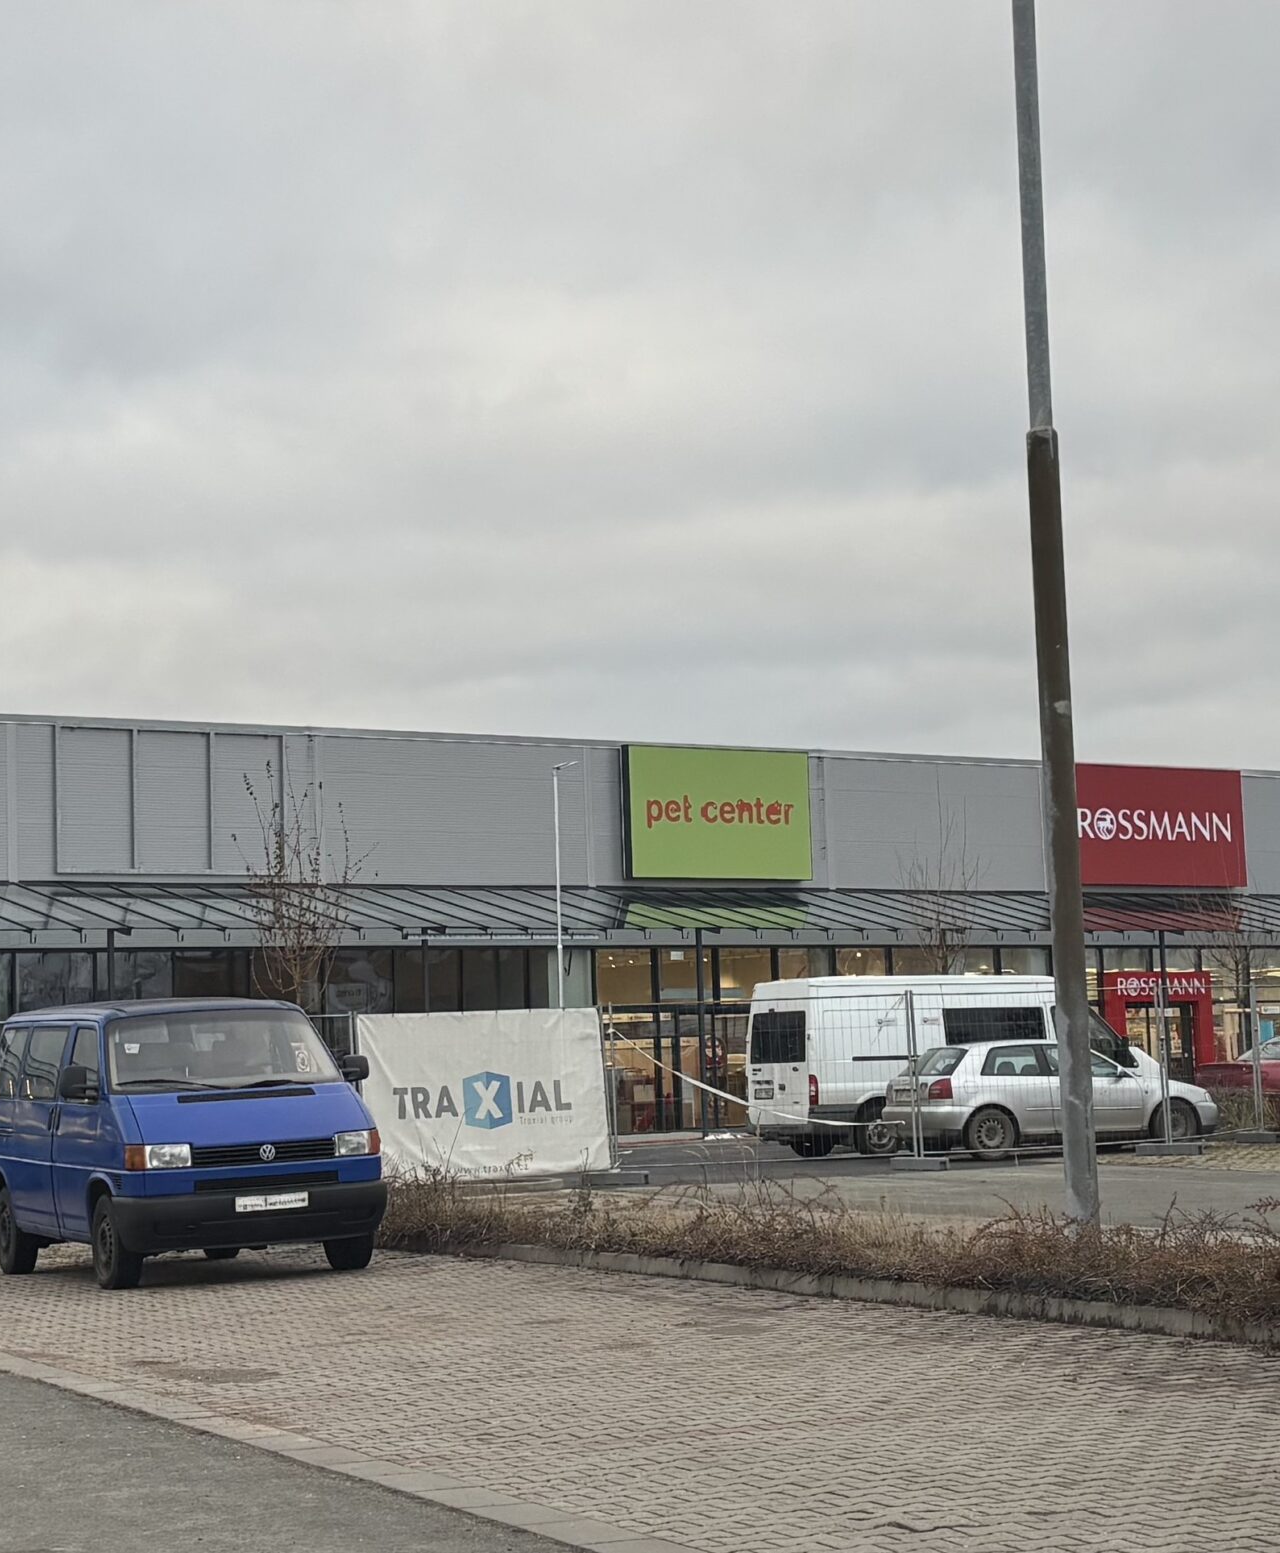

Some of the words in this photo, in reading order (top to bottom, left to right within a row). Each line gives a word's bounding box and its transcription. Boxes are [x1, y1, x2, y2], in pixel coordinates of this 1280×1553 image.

[646, 795, 693, 829] pet
[700, 798, 794, 825] center
[1076, 807, 1232, 843] ROSSMANN
[393, 1080, 572, 1120] TRAXIAL
